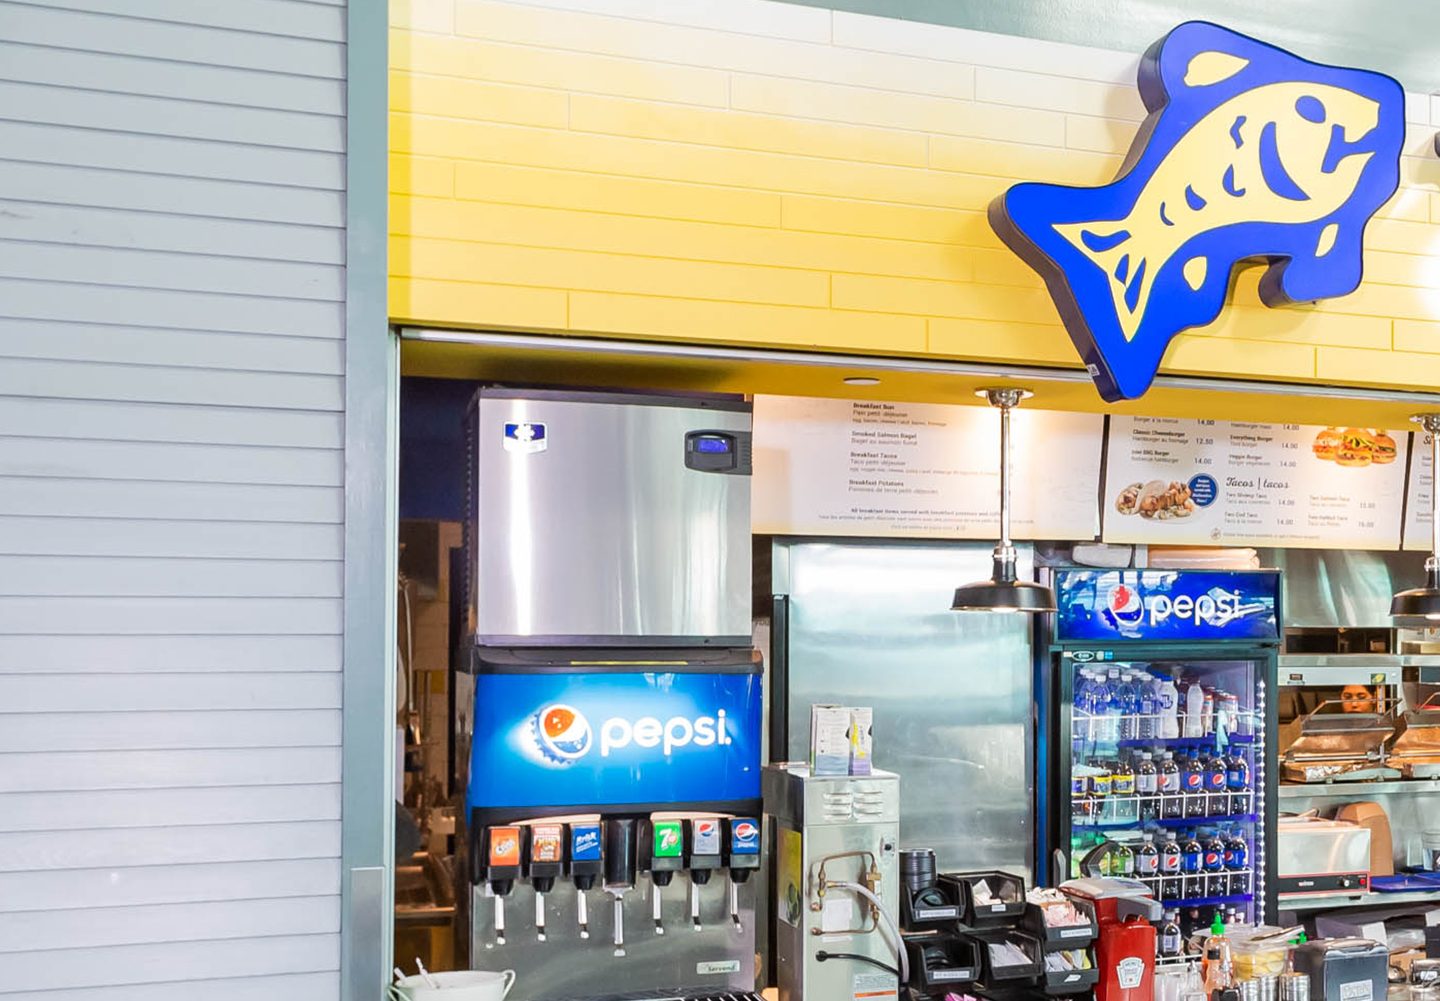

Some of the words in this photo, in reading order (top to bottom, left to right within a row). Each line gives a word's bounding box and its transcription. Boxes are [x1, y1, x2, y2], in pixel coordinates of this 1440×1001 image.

[1226, 477, 1254, 487] Tacos
[1150, 589, 1241, 626] pepsi
[601, 708, 729, 757] pepsi
